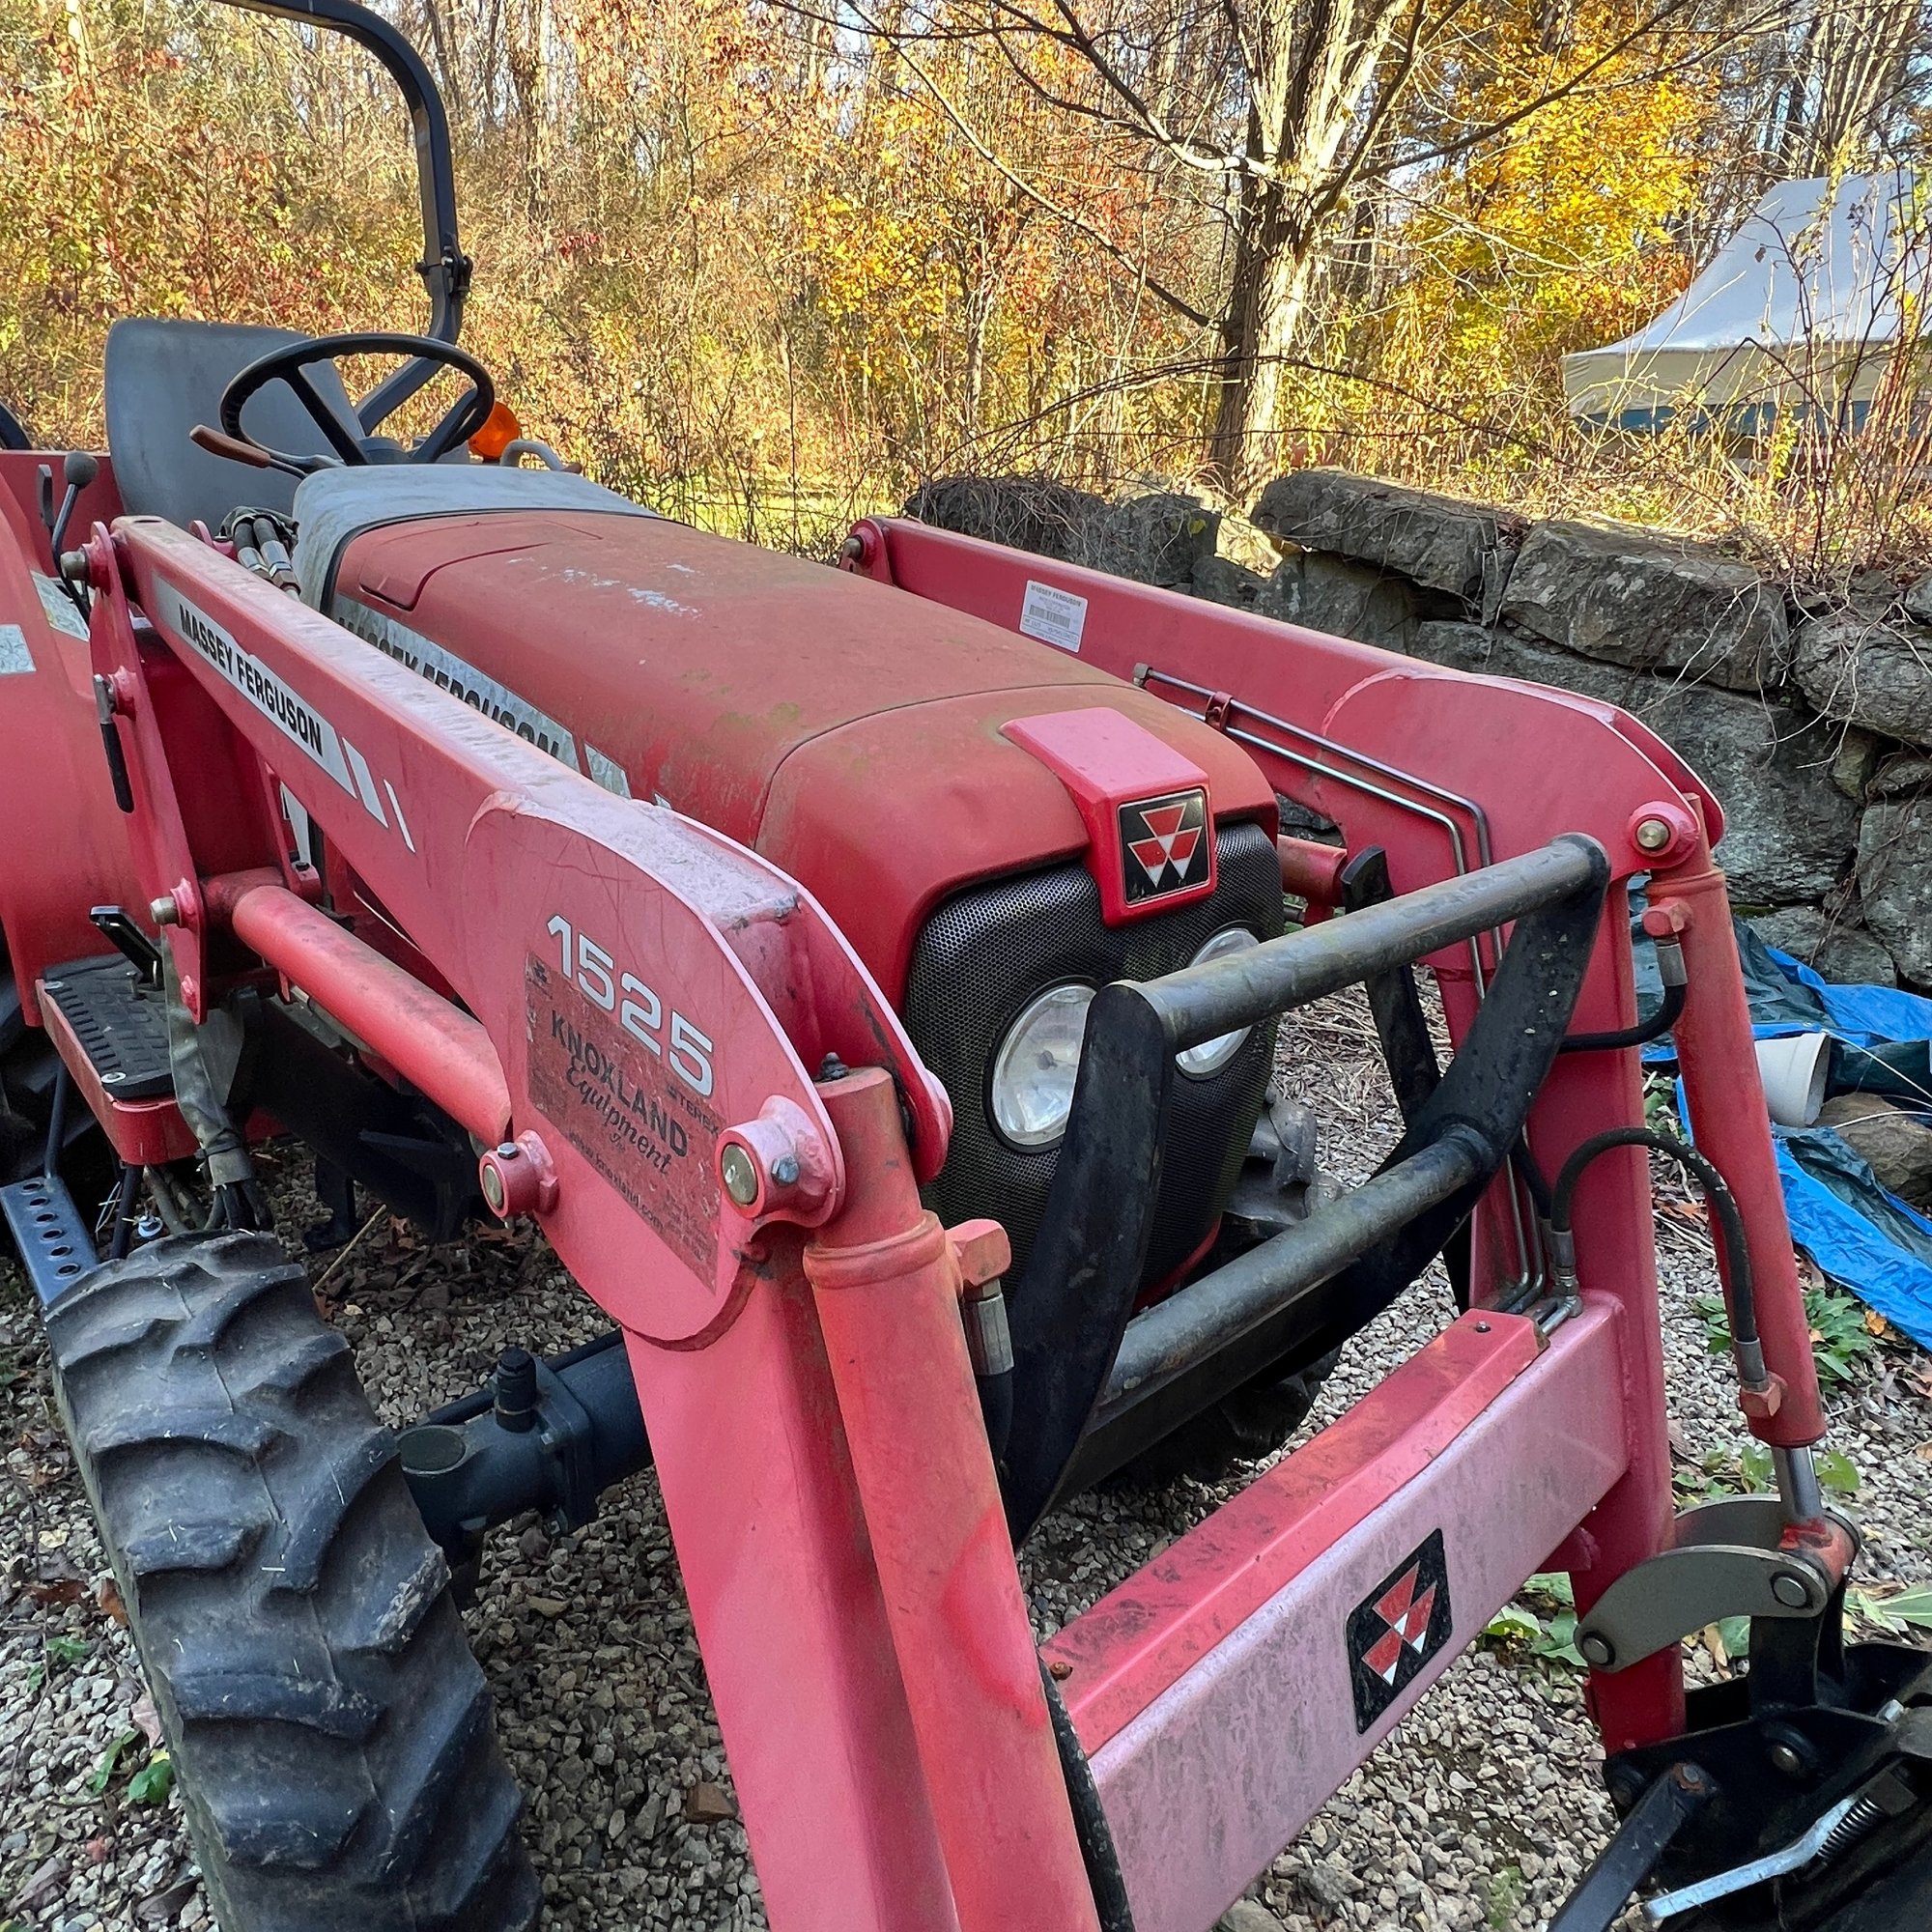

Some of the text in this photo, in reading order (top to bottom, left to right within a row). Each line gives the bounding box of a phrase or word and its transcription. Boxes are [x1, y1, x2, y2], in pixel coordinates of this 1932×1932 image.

[178, 603, 234, 675] MASSEY
[236, 651, 324, 757] FERGUSON
[547, 914, 714, 1096] 1525
[551, 1009, 688, 1158] KNOXLAND
[565, 1054, 673, 1176] Equipment
